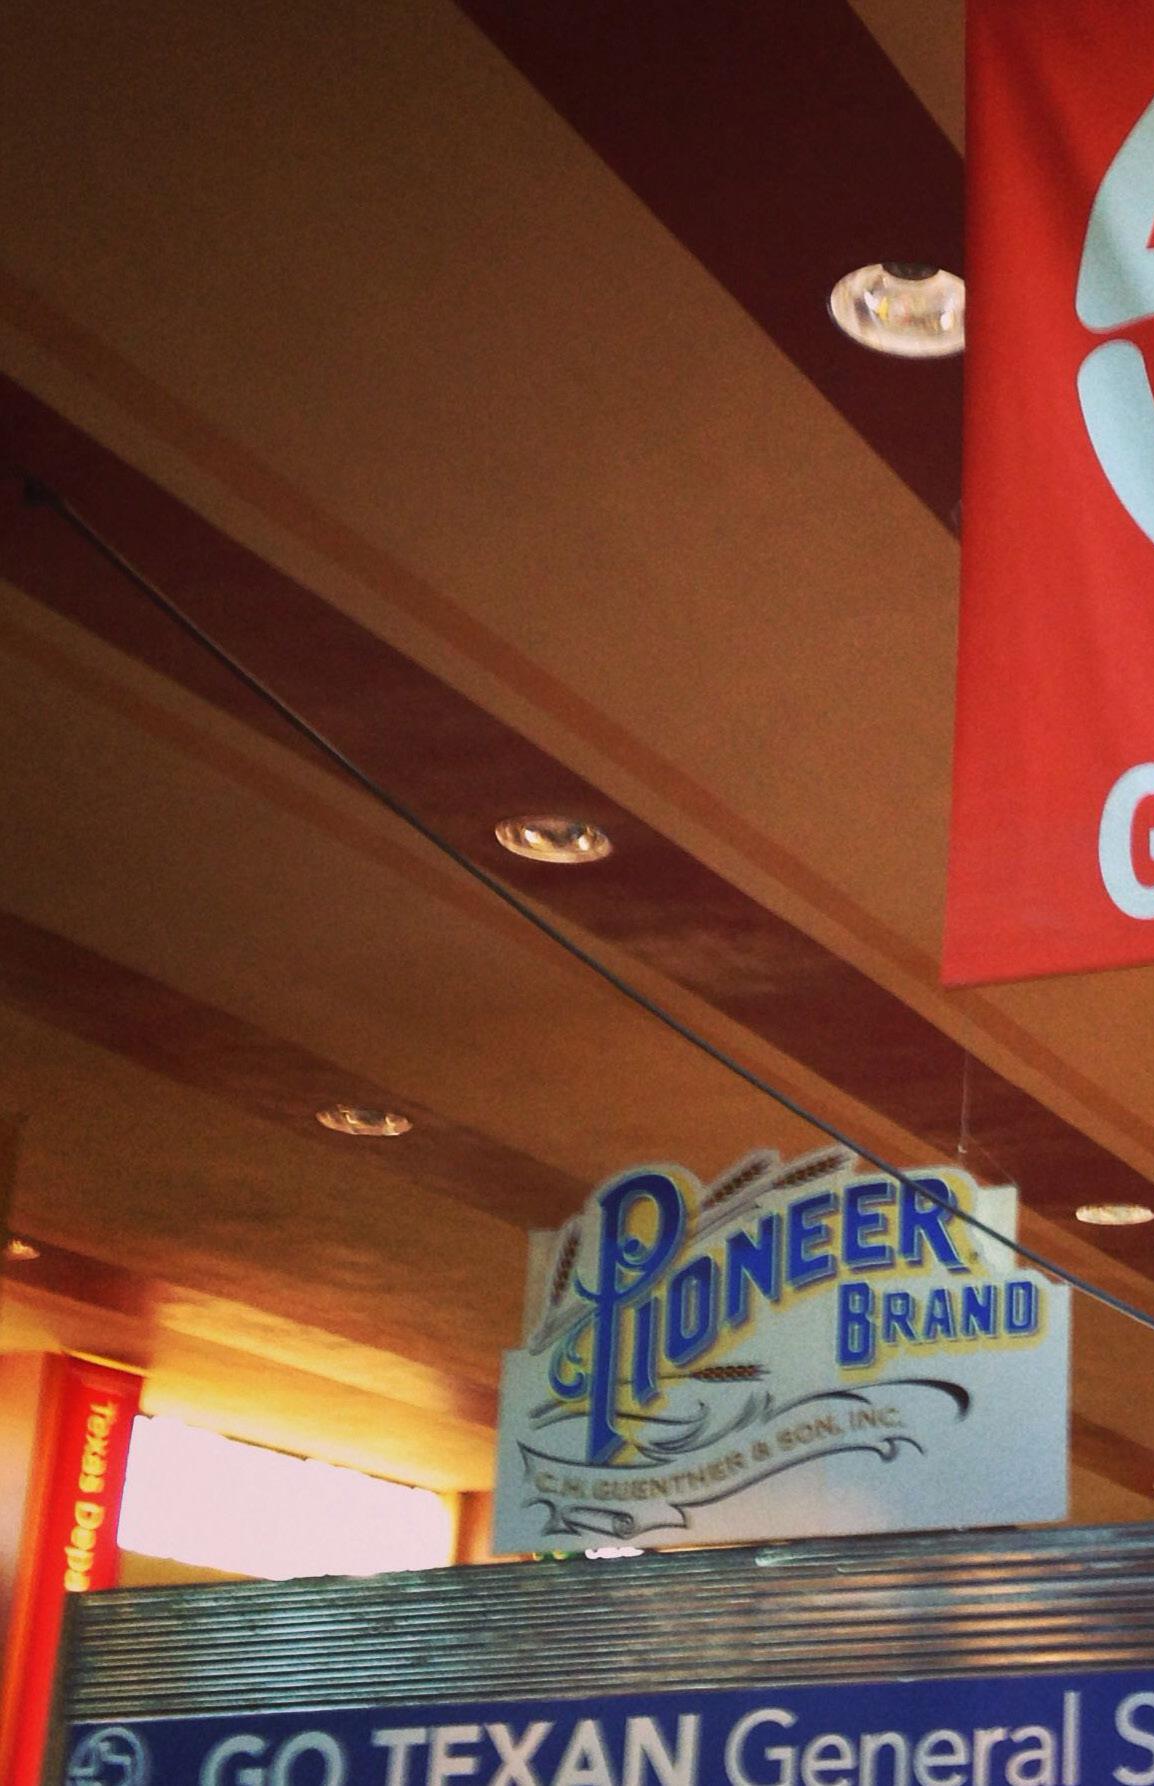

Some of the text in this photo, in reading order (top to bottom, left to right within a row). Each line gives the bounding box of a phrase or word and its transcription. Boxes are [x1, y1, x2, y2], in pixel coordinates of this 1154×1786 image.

[547, 1172, 970, 1465] PIONEER
[836, 1279, 1041, 1368] BRAND
[78, 1401, 117, 1493] Texas
[592, 1450, 746, 1501] GUENTHER
[201, 1730, 344, 1786] GO
[371, 1714, 701, 1786] TEXAN
[723, 1690, 1080, 1786] General
